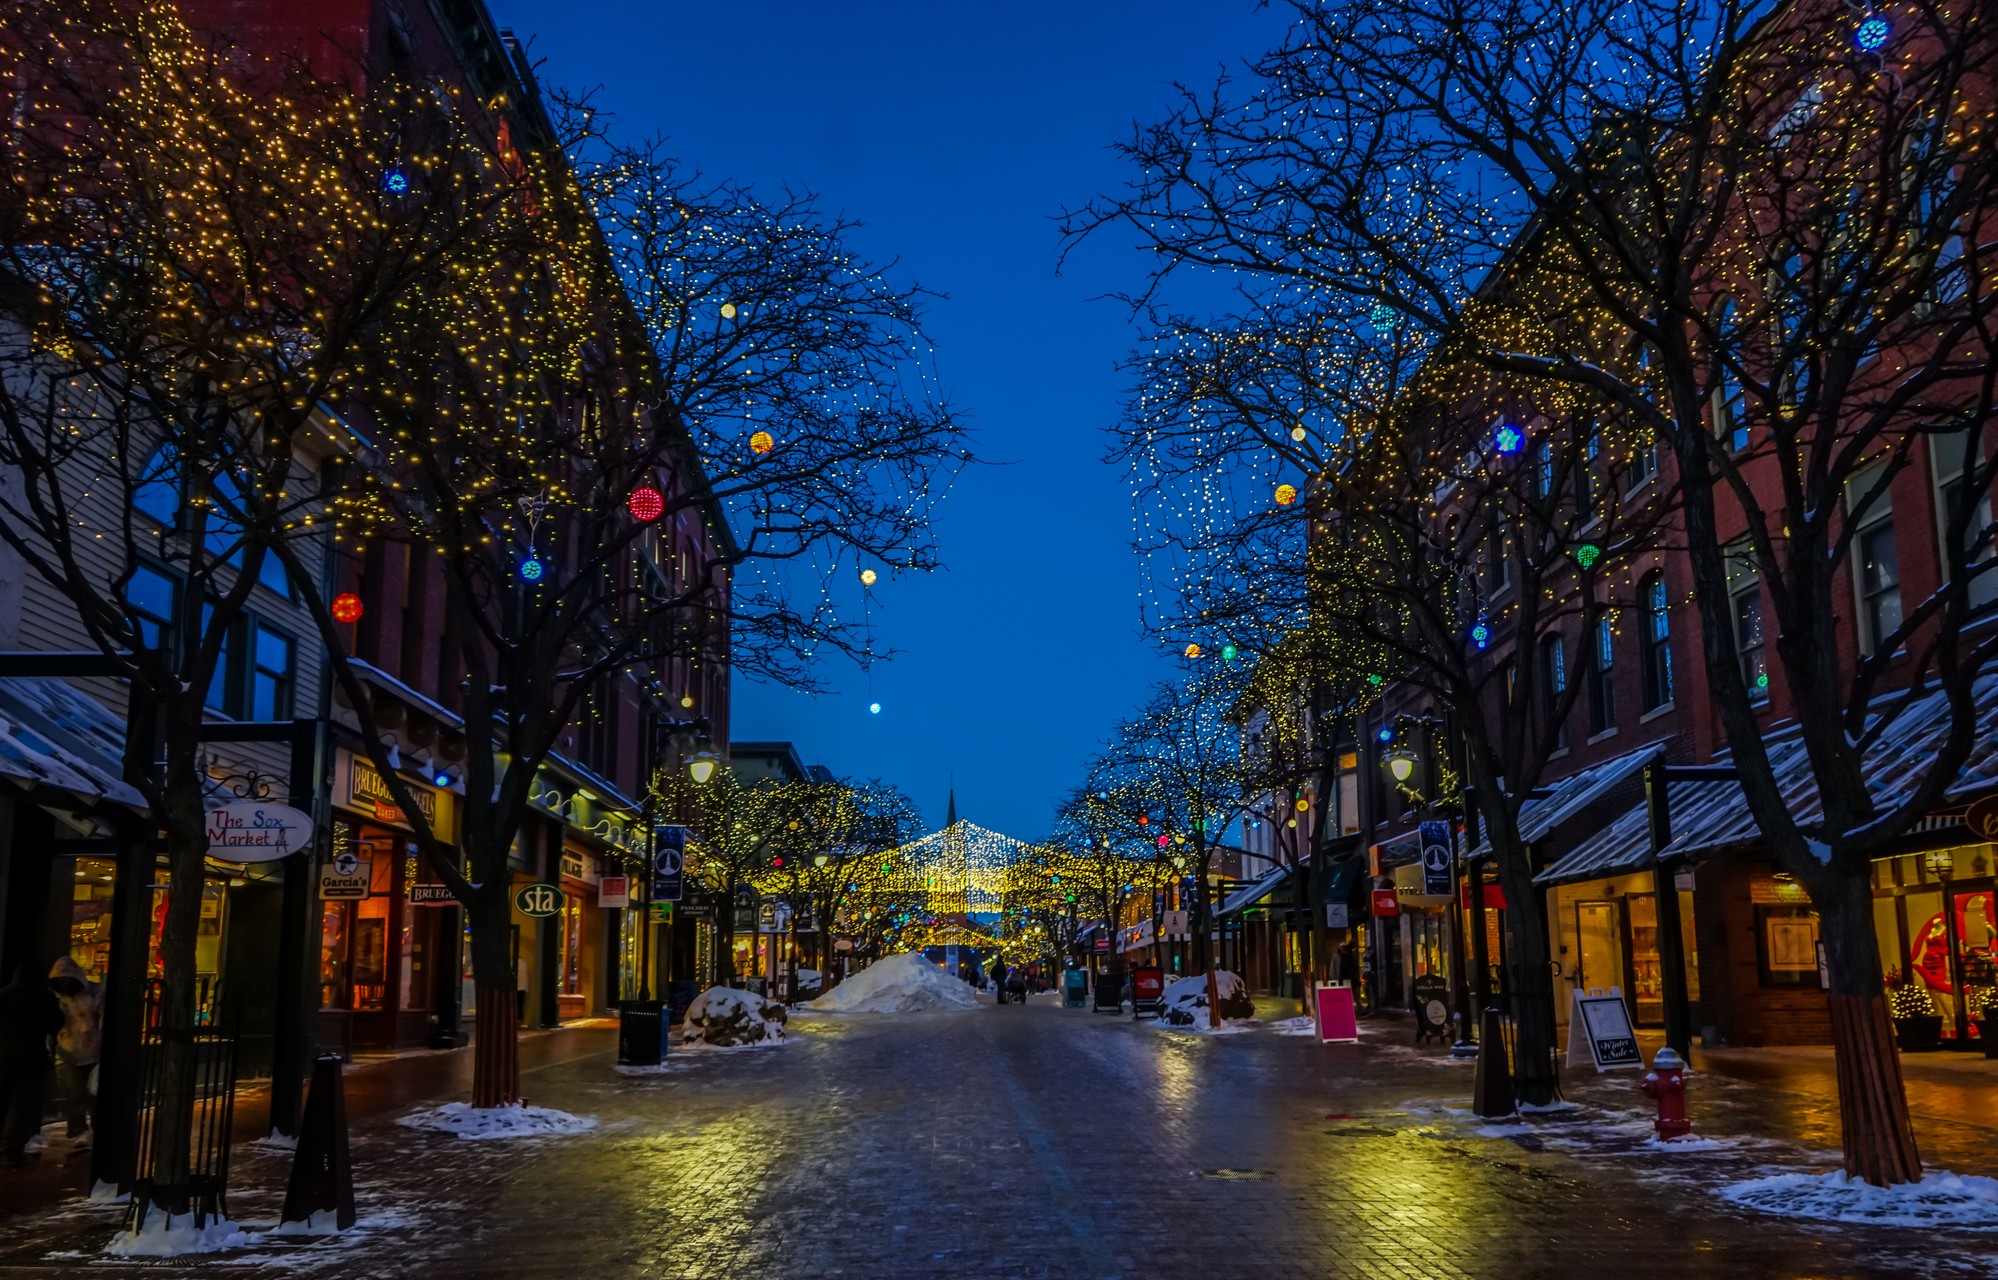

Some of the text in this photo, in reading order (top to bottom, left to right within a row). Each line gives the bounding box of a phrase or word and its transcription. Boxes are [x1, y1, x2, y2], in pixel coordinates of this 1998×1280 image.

[211, 810, 284, 829] The Sox
[208, 828, 270, 847] Market
[322, 877, 367, 887] Garcia's
[524, 886, 555, 912] sta
[1600, 1039, 1629, 1051] Winter
[1607, 1047, 1628, 1059] Sale
